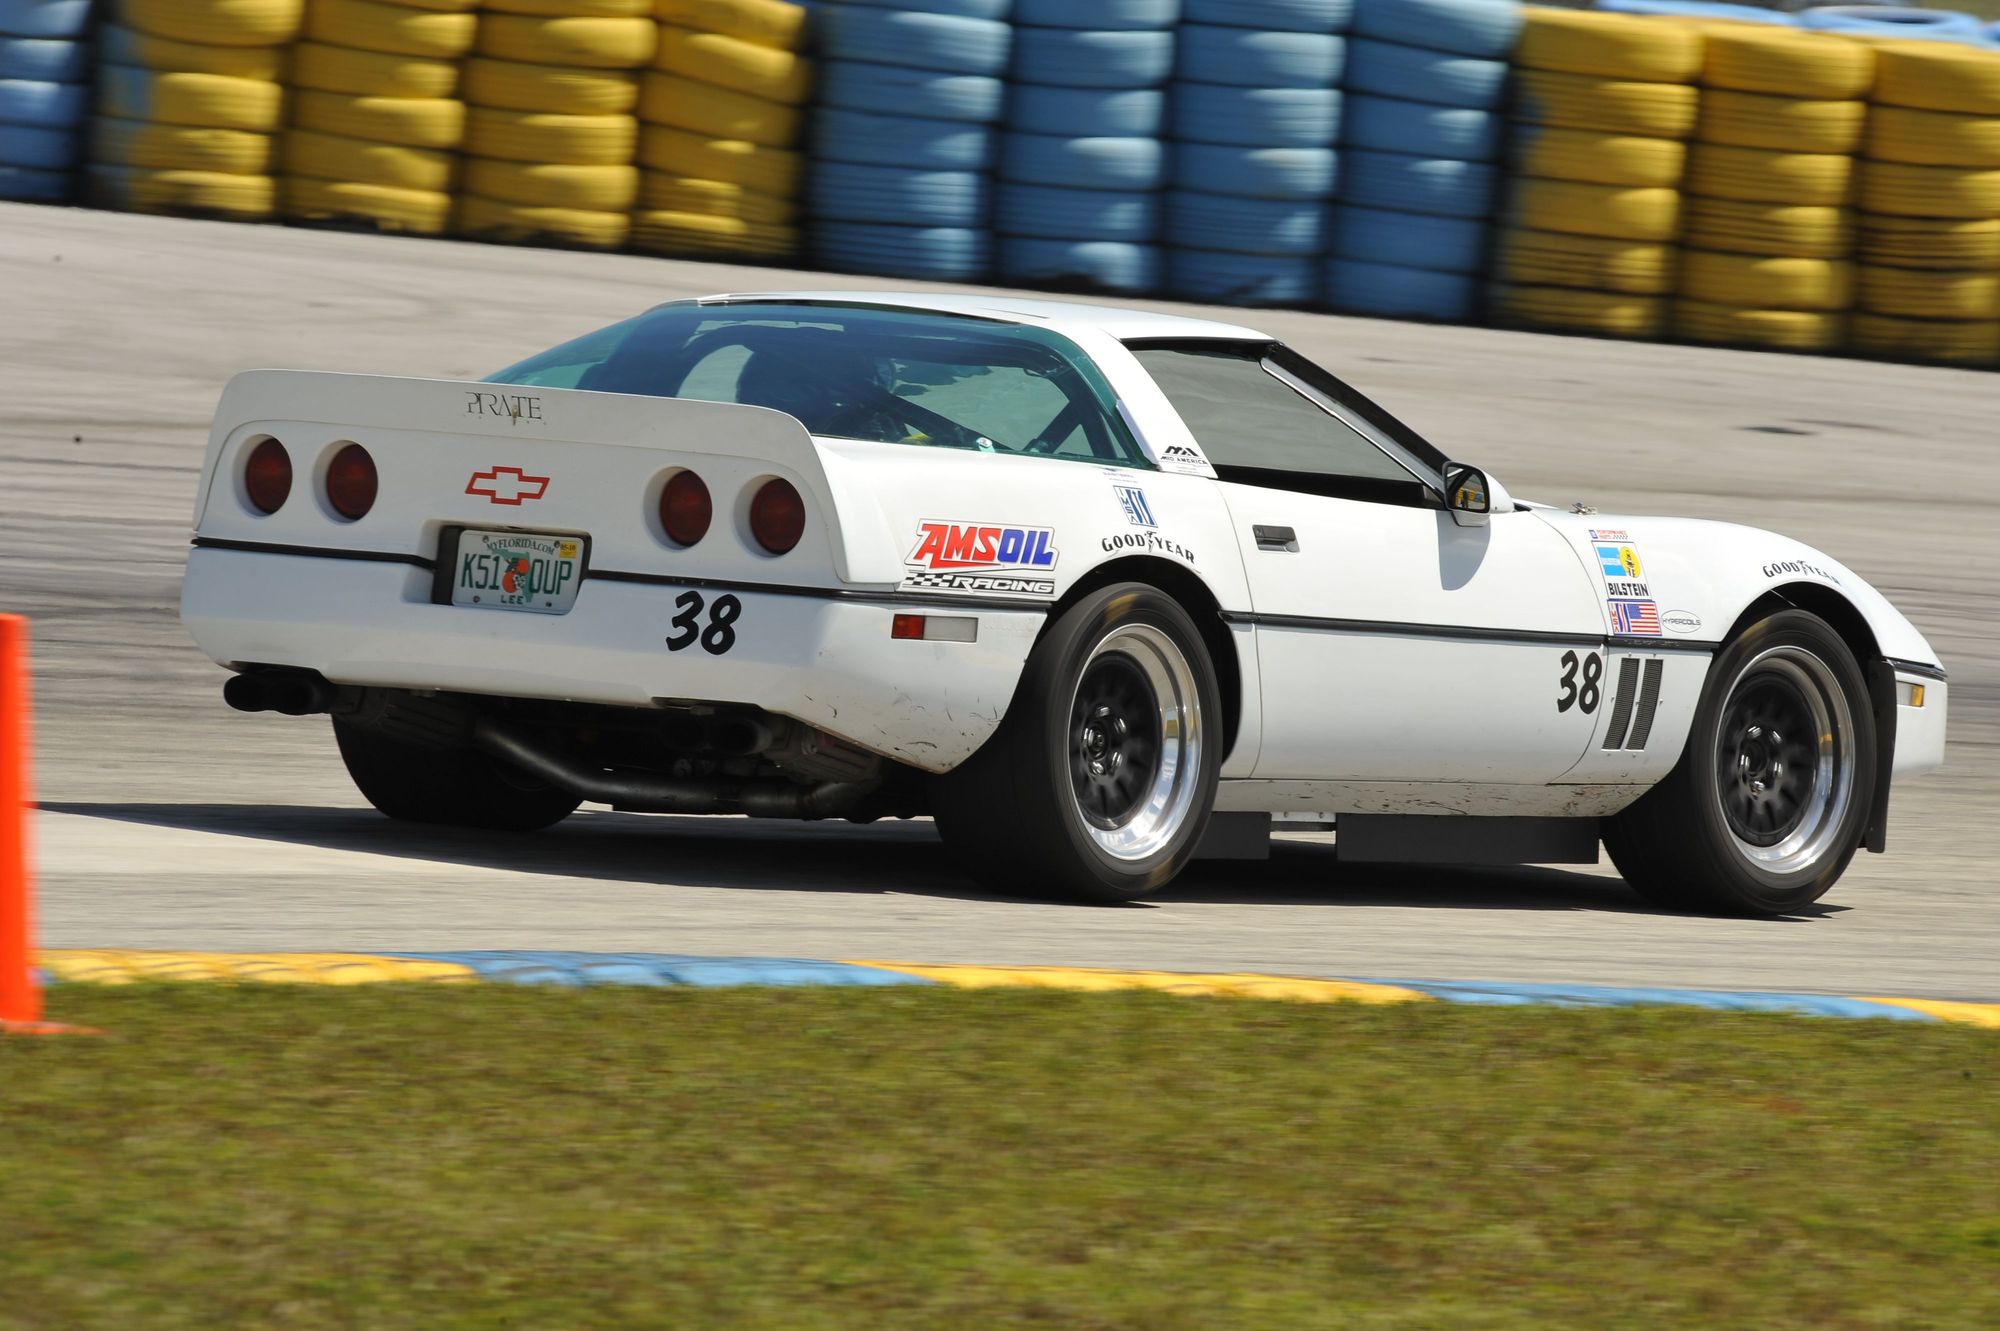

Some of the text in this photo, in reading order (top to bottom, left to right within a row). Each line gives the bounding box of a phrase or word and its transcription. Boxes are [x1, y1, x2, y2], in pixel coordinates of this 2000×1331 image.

[465, 392, 542, 419] PIRATE
[1177, 457, 1208, 465] AMERICA
[913, 523, 1054, 569] AMSOIL
[1102, 534, 1194, 564] GOODYEAR
[461, 553, 500, 590] K51
[952, 576, 1053, 593] RACING
[501, 595, 524, 605] LEE
[1608, 583, 1649, 597] BILSTEIN
[666, 590, 742, 656] 38
[1662, 618, 1701, 626] HYPERCOILS
[1557, 650, 1603, 715] 38
